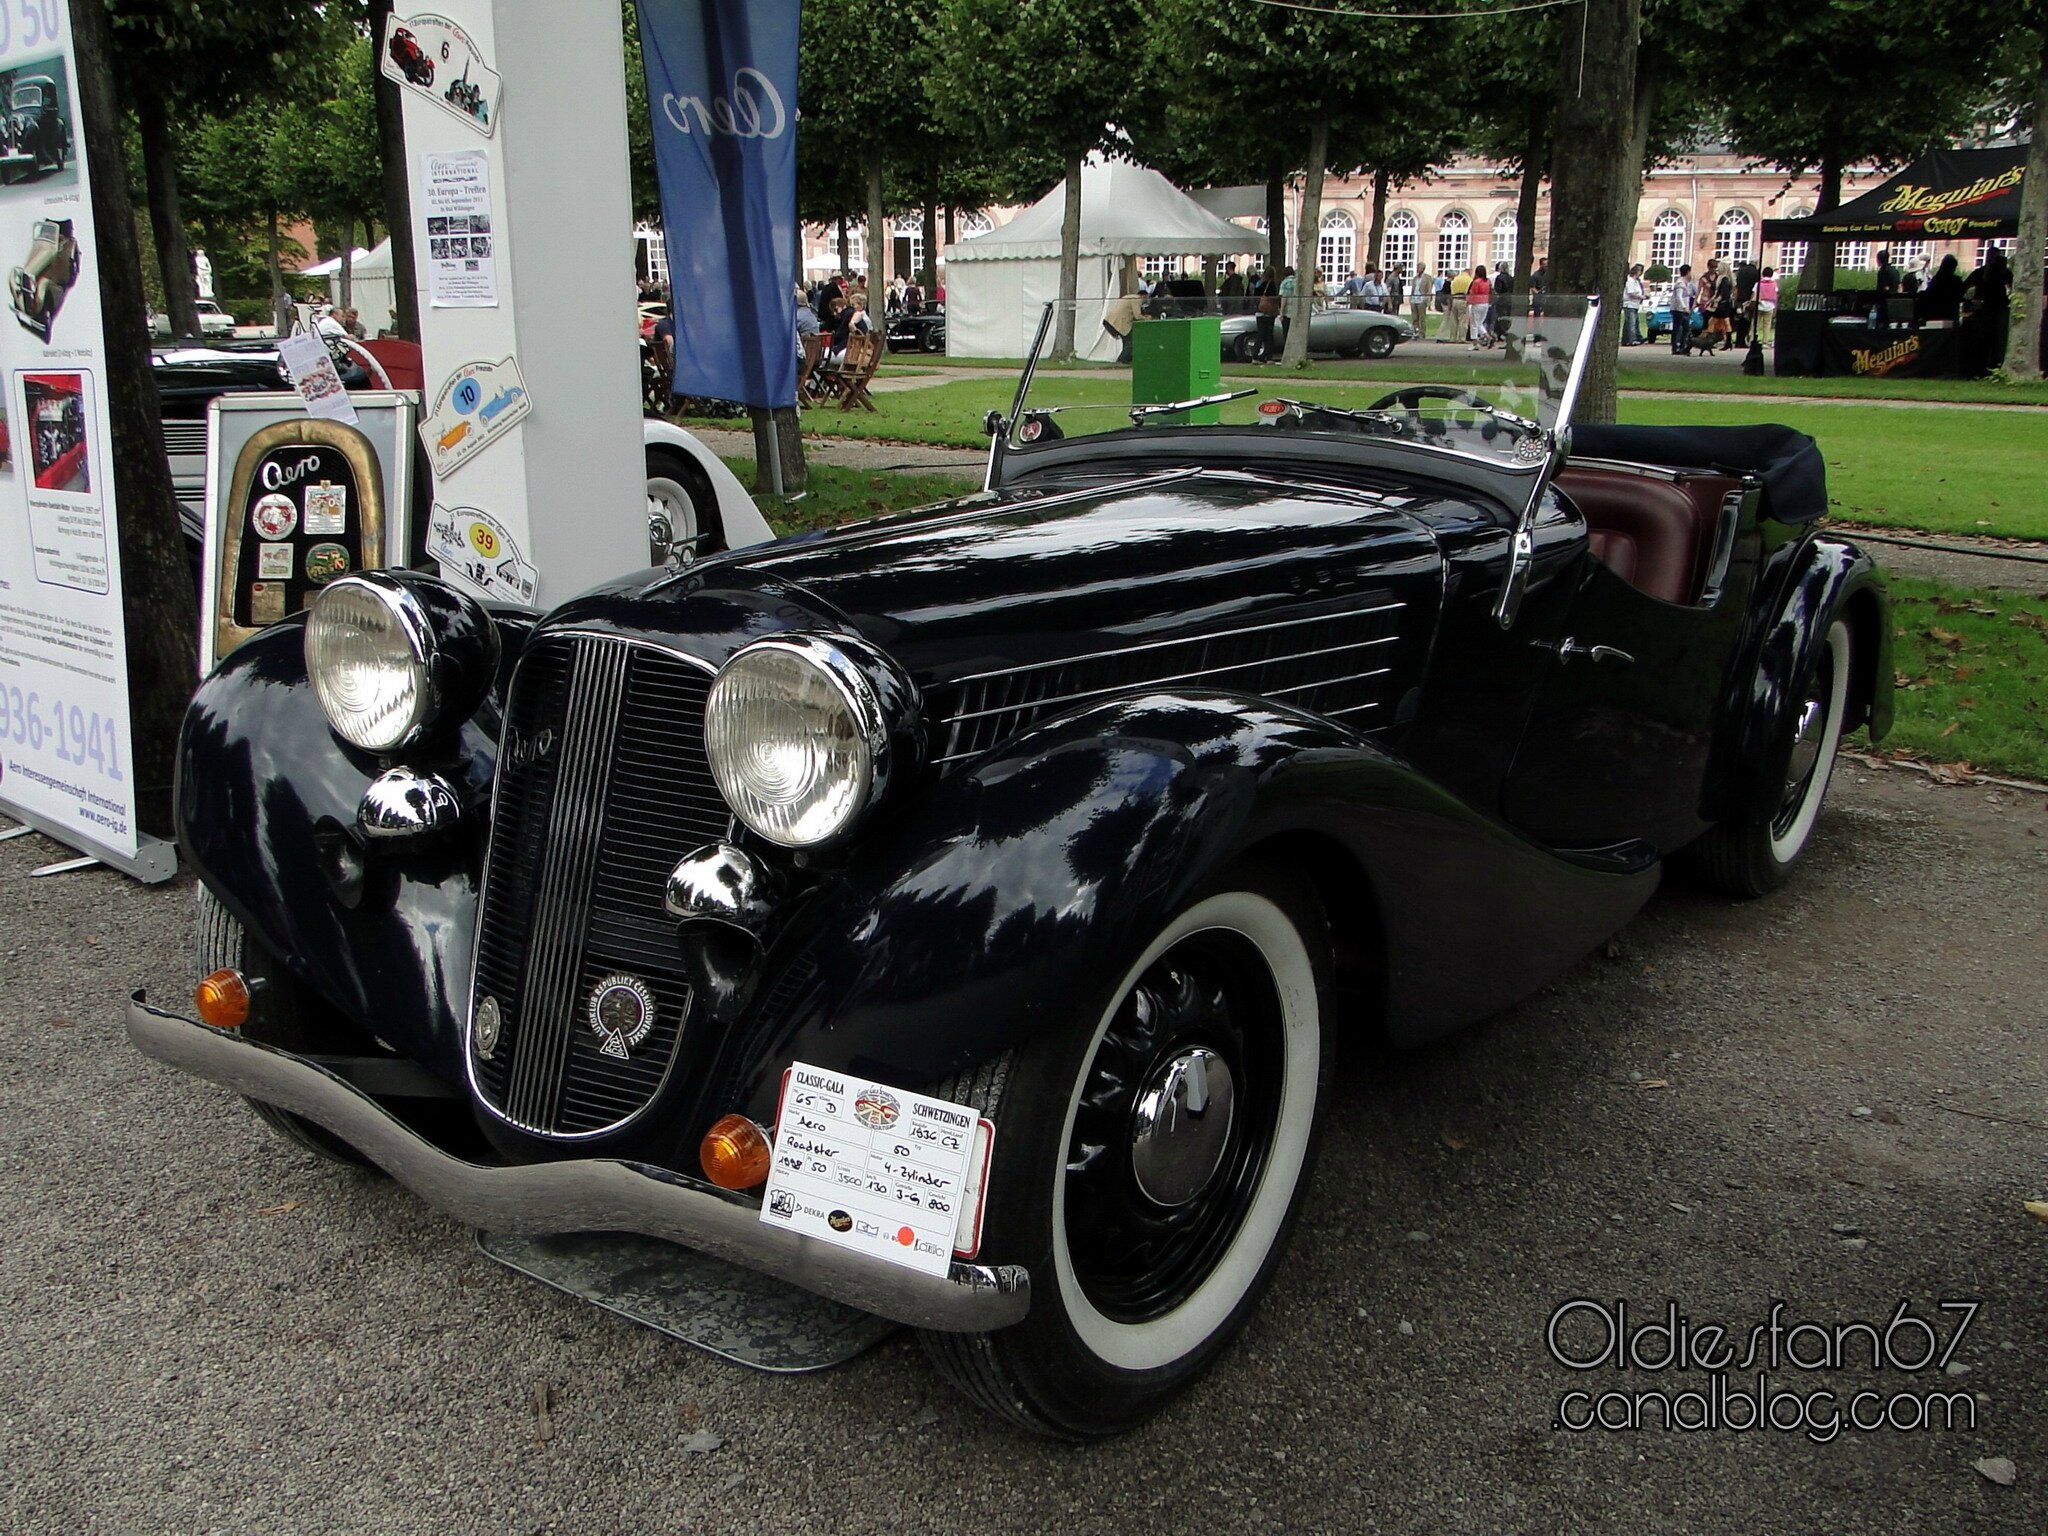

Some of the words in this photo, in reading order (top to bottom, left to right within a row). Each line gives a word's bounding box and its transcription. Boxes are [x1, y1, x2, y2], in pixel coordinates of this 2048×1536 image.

[441, 41, 450, 60] 6
[431, 168, 479, 176] INTERNATIONAL
[437, 187, 459, 197] Europa
[464, 185, 487, 195] Treffen
[1849, 224, 1861, 232] Car
[1924, 217, 1967, 236] Crazy
[459, 385, 475, 406] 10
[263, 455, 320, 490] Aero
[476, 529, 493, 550] 39
[9, 760, 21, 774] Aero
[87, 790, 126, 817] International
[79, 807, 127, 835] www.aero-ig.de
[594, 976, 635, 995] REPUBLIKY
[588, 996, 606, 1037] AUTOKLUB
[796, 1071, 844, 1096] CLASSIC-GALA
[912, 1102, 971, 1129] SCHWETZINGEN
[796, 1116, 826, 1132] Aero
[786, 1136, 839, 1157] Roadster
[893, 1145, 910, 1157] 50
[811, 1162, 827, 1173] 50
[865, 1181, 887, 1193] 130
[928, 1199, 951, 1212] 800
[804, 1206, 825, 1220] DEKRA
